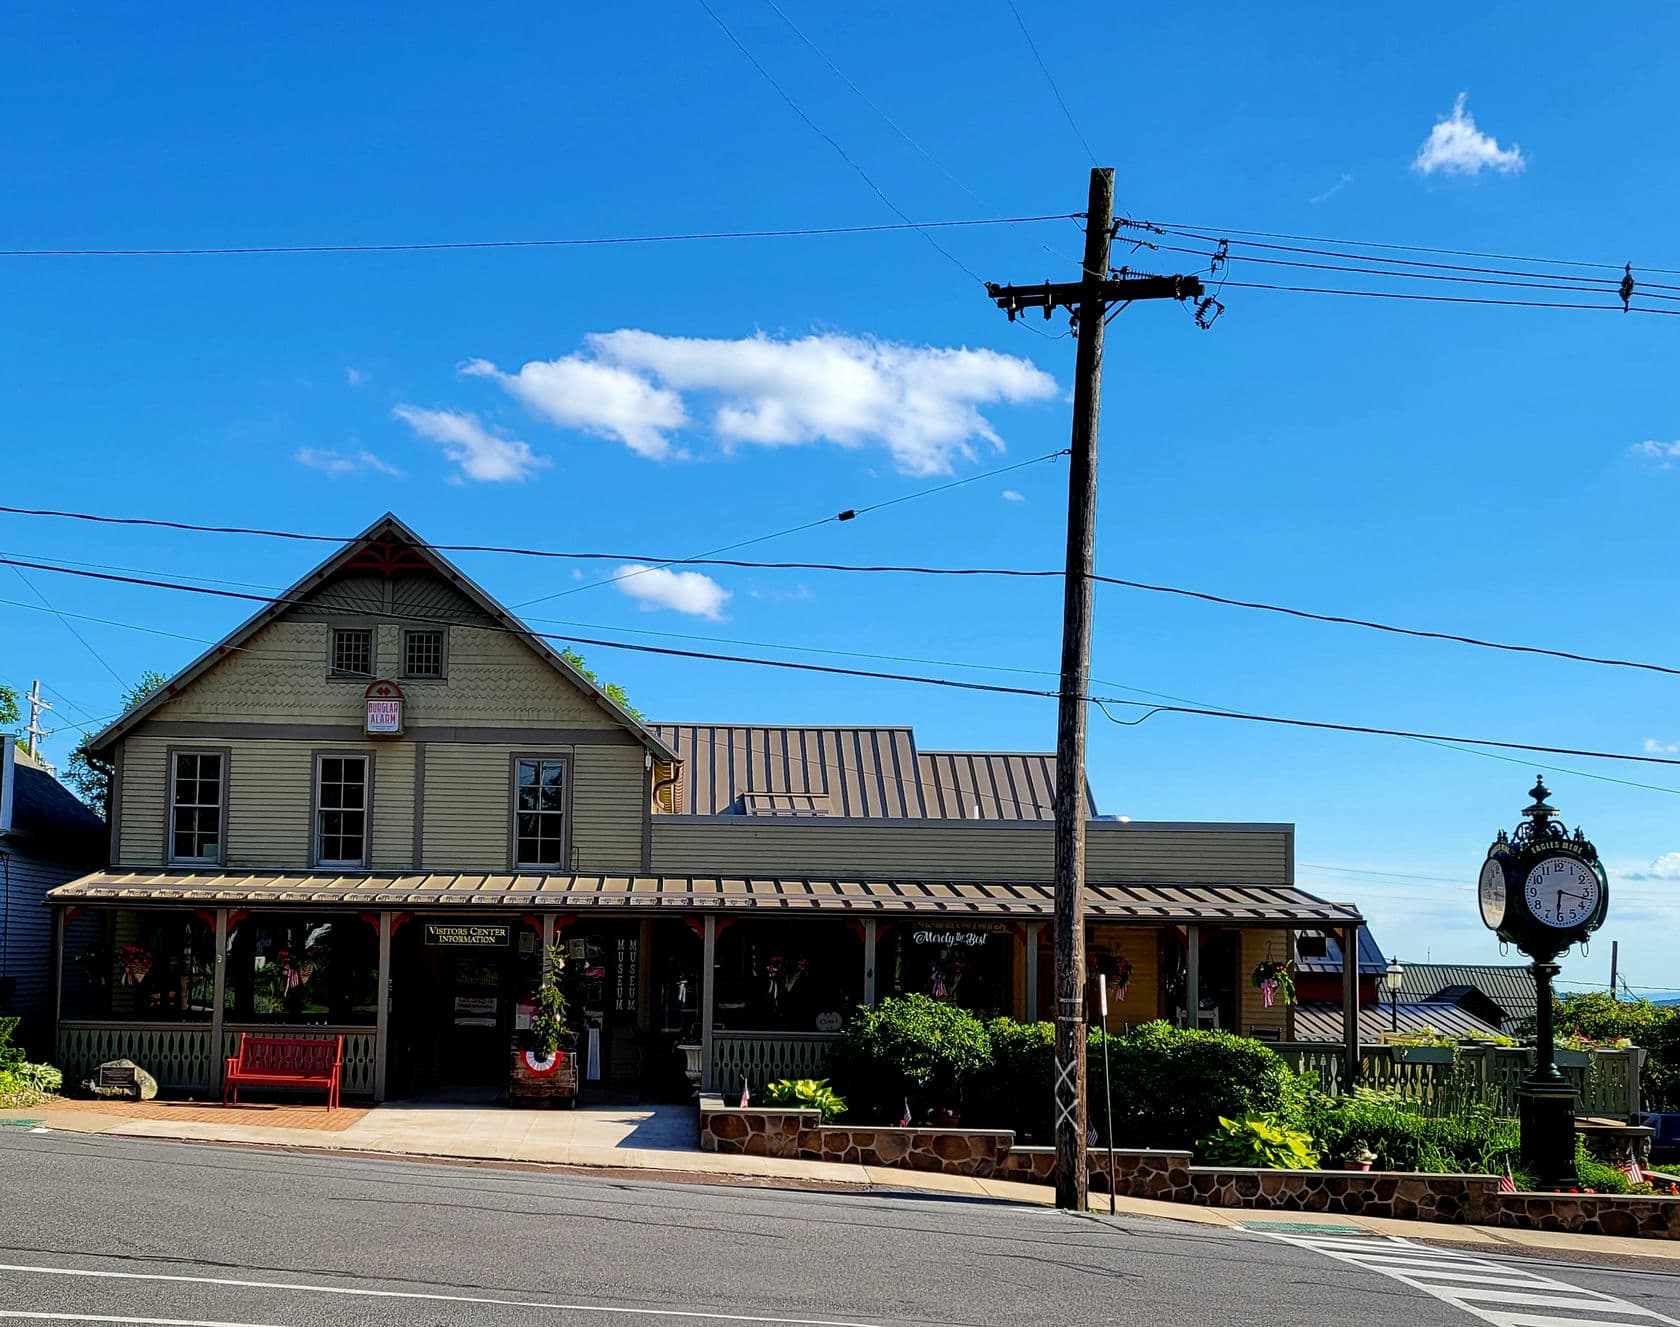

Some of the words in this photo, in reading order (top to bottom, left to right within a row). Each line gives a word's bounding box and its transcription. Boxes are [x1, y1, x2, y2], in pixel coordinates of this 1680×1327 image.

[368, 702, 398, 713] BURGLAR
[370, 713, 396, 724] ALARM
[1542, 866, 1551, 876] 11
[1554, 863, 1564, 873] 12
[1569, 866, 1574, 876] 1
[1533, 875, 1543, 884] 10
[1578, 875, 1586, 885] 2
[1530, 888, 1537, 897] 9
[1582, 887, 1590, 897] 3
[1534, 900, 1541, 910] 8
[1578, 901, 1586, 911] 4
[1545, 909, 1551, 919] 7
[1556, 912, 1564, 922] 6
[1569, 909, 1577, 920] 5
[429, 926, 468, 935] VISITORS
[470, 927, 506, 936] CENTER
[439, 935, 496, 943] INFORMATION
[964, 932, 987, 946] Best
[615, 939, 625, 1011] MUSEUM
[627, 939, 638, 1011] MUSEUM
